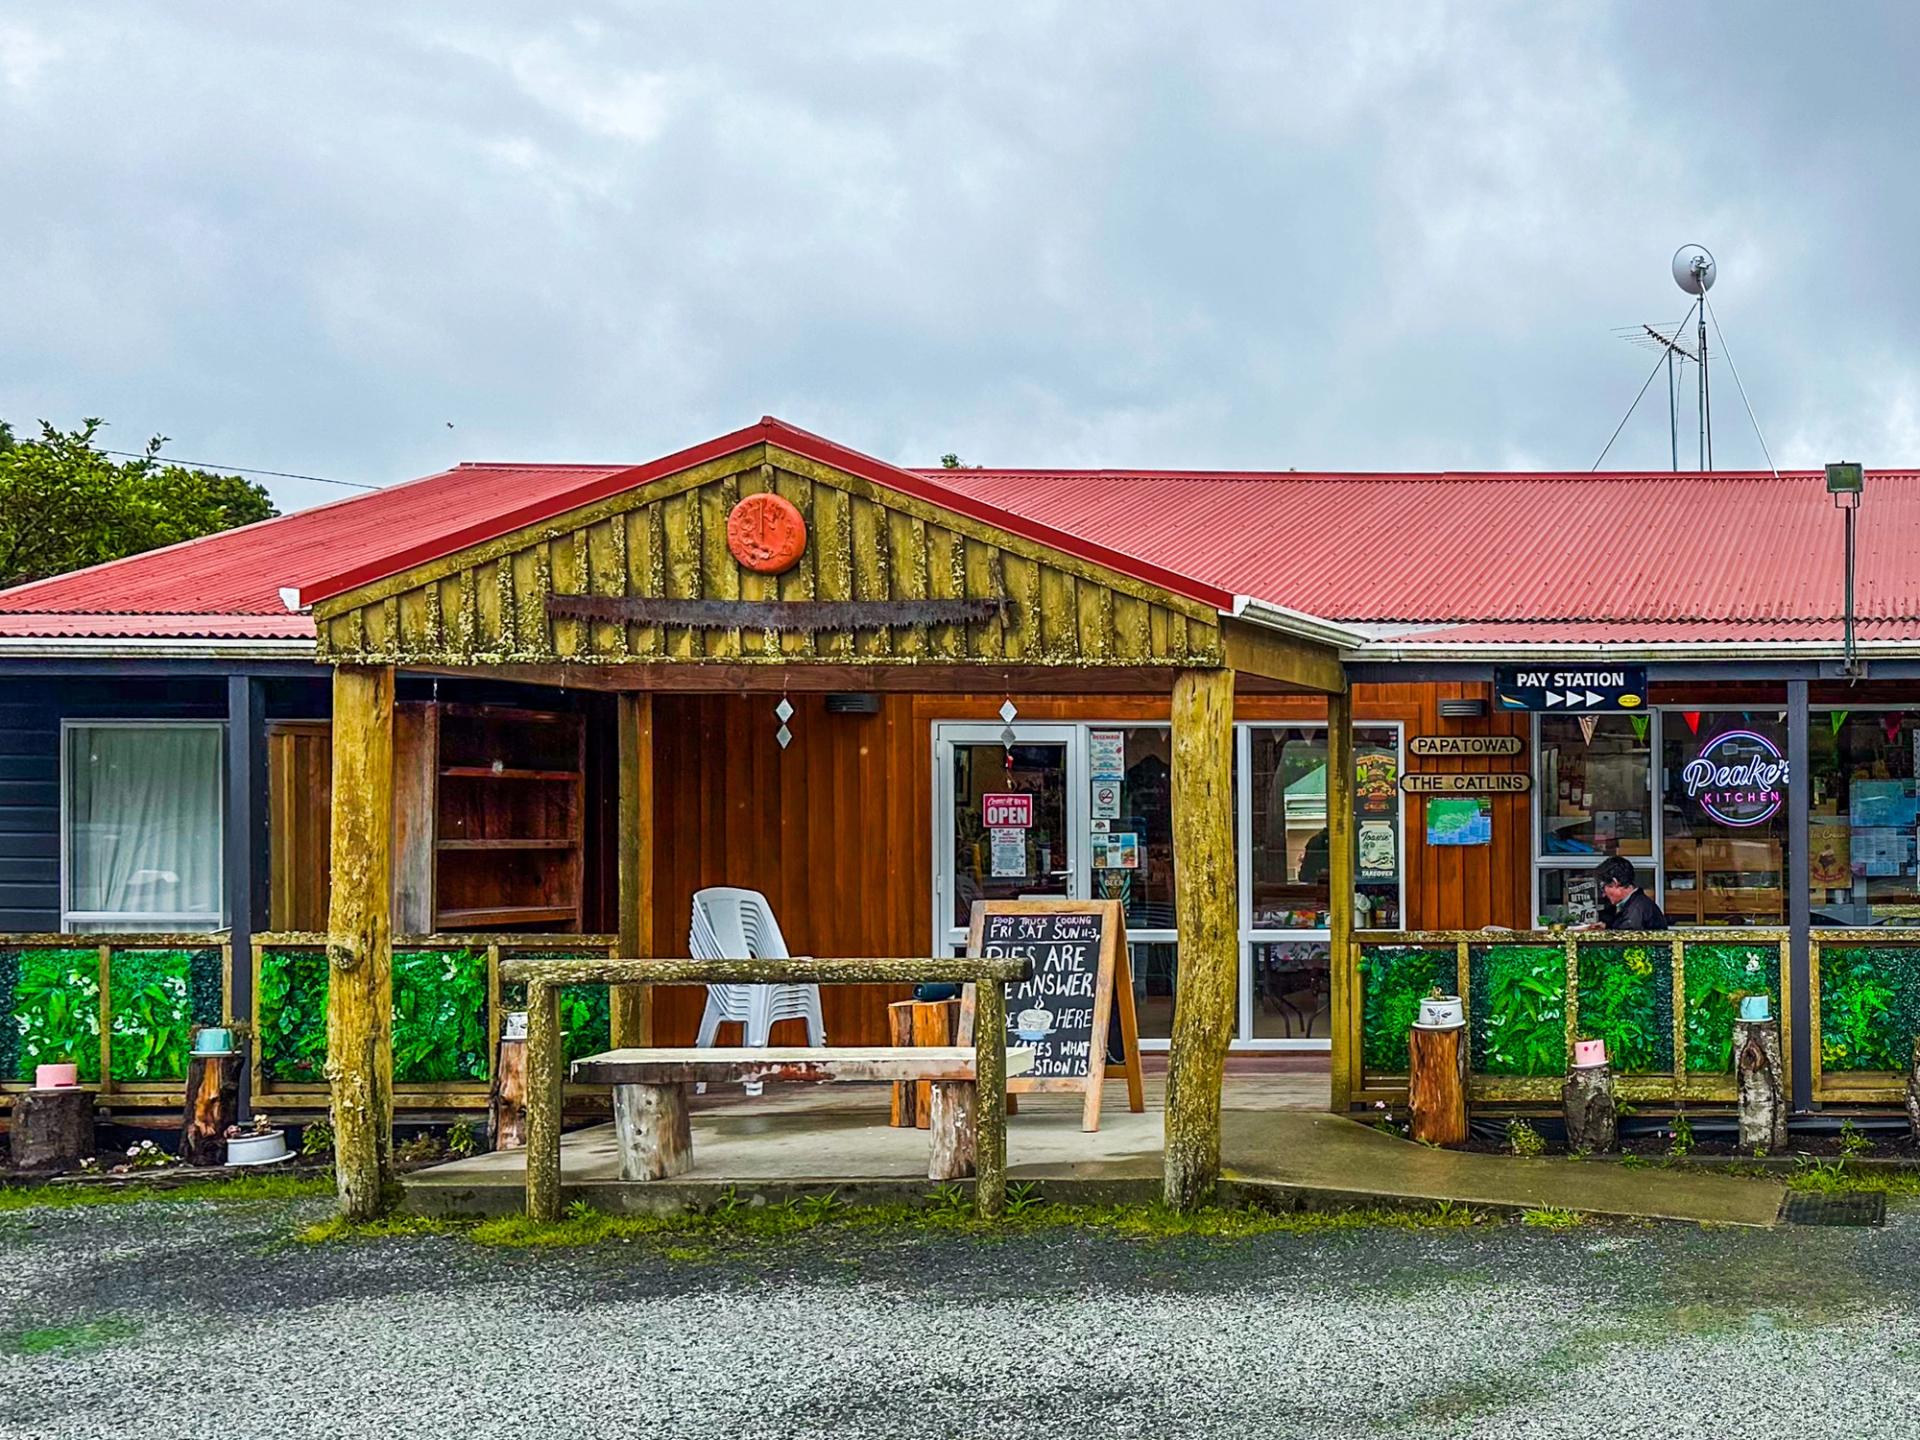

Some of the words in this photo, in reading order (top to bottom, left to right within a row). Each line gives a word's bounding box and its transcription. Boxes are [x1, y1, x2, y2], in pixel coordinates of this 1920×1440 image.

[1517, 673, 1549, 687] PAY
[1554, 672, 1625, 687] STATION
[1417, 739, 1515, 752] PAPATOWAI
[1410, 777, 1443, 790] THE
[1454, 776, 1523, 790] CATLINS
[1704, 791, 1780, 804] KITCHEN
[987, 807, 1028, 824] OPEN
[993, 917, 1014, 926] FOOD
[1020, 917, 1047, 927] TRUCK
[1055, 916, 1092, 925] COOKING
[990, 924, 1012, 938] FRI
[1018, 925, 1045, 939] SAT
[1043, 944, 1087, 972] ARE
[1017, 973, 1095, 999] ANSWER.
[1055, 1008, 1093, 1029] HERE
[1060, 1040, 1091, 1057] WHAT
[1073, 1060, 1087, 1076] IS
